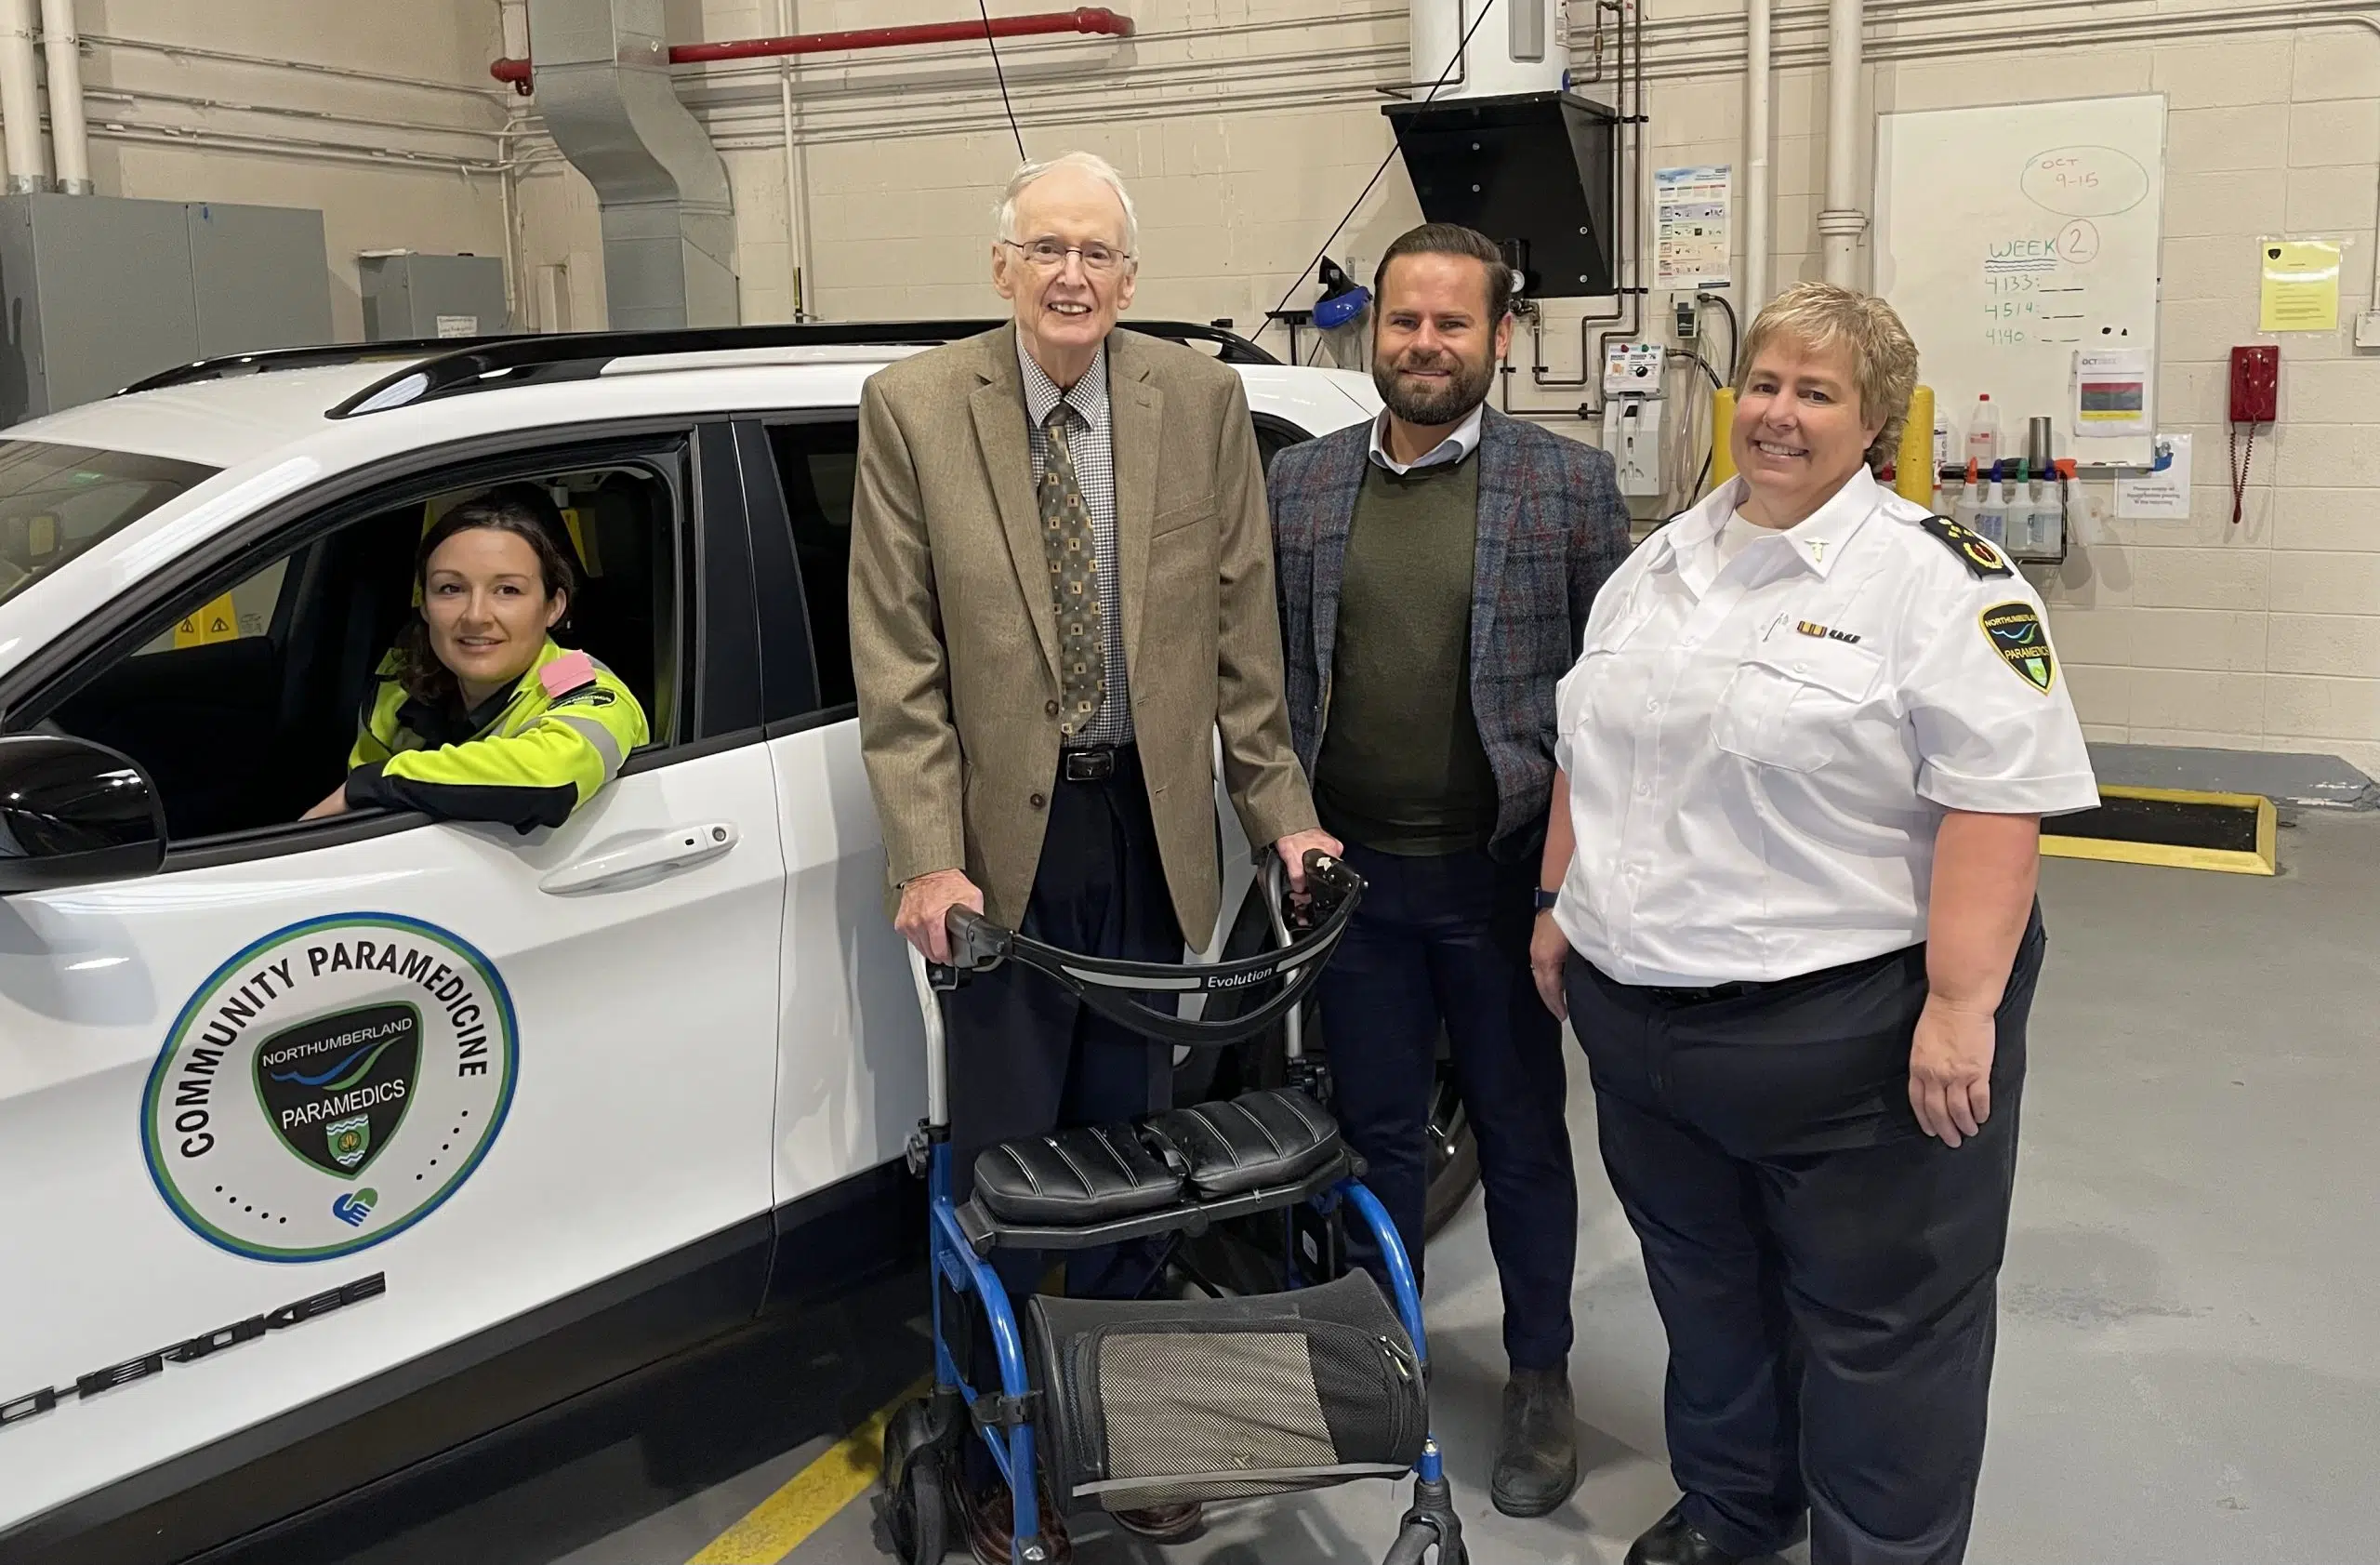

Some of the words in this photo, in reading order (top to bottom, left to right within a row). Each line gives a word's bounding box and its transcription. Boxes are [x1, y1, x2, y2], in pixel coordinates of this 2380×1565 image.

[2041, 158, 2080, 170] OCT
[2056, 172, 2099, 188] 9-15
[1990, 237, 2056, 259] WEEK
[2069, 229, 2088, 254] 2
[2004, 646, 2050, 659] PARAMEDICS
[1207, 966, 1273, 988] Evolution
[175, 958, 295, 1158] COMMUNITY
[308, 941, 487, 1078] PARAMEDICINE
[262, 1017, 413, 1068] NORTHUMBERLAND
[282, 1079, 405, 1130] PARAMEDICS
